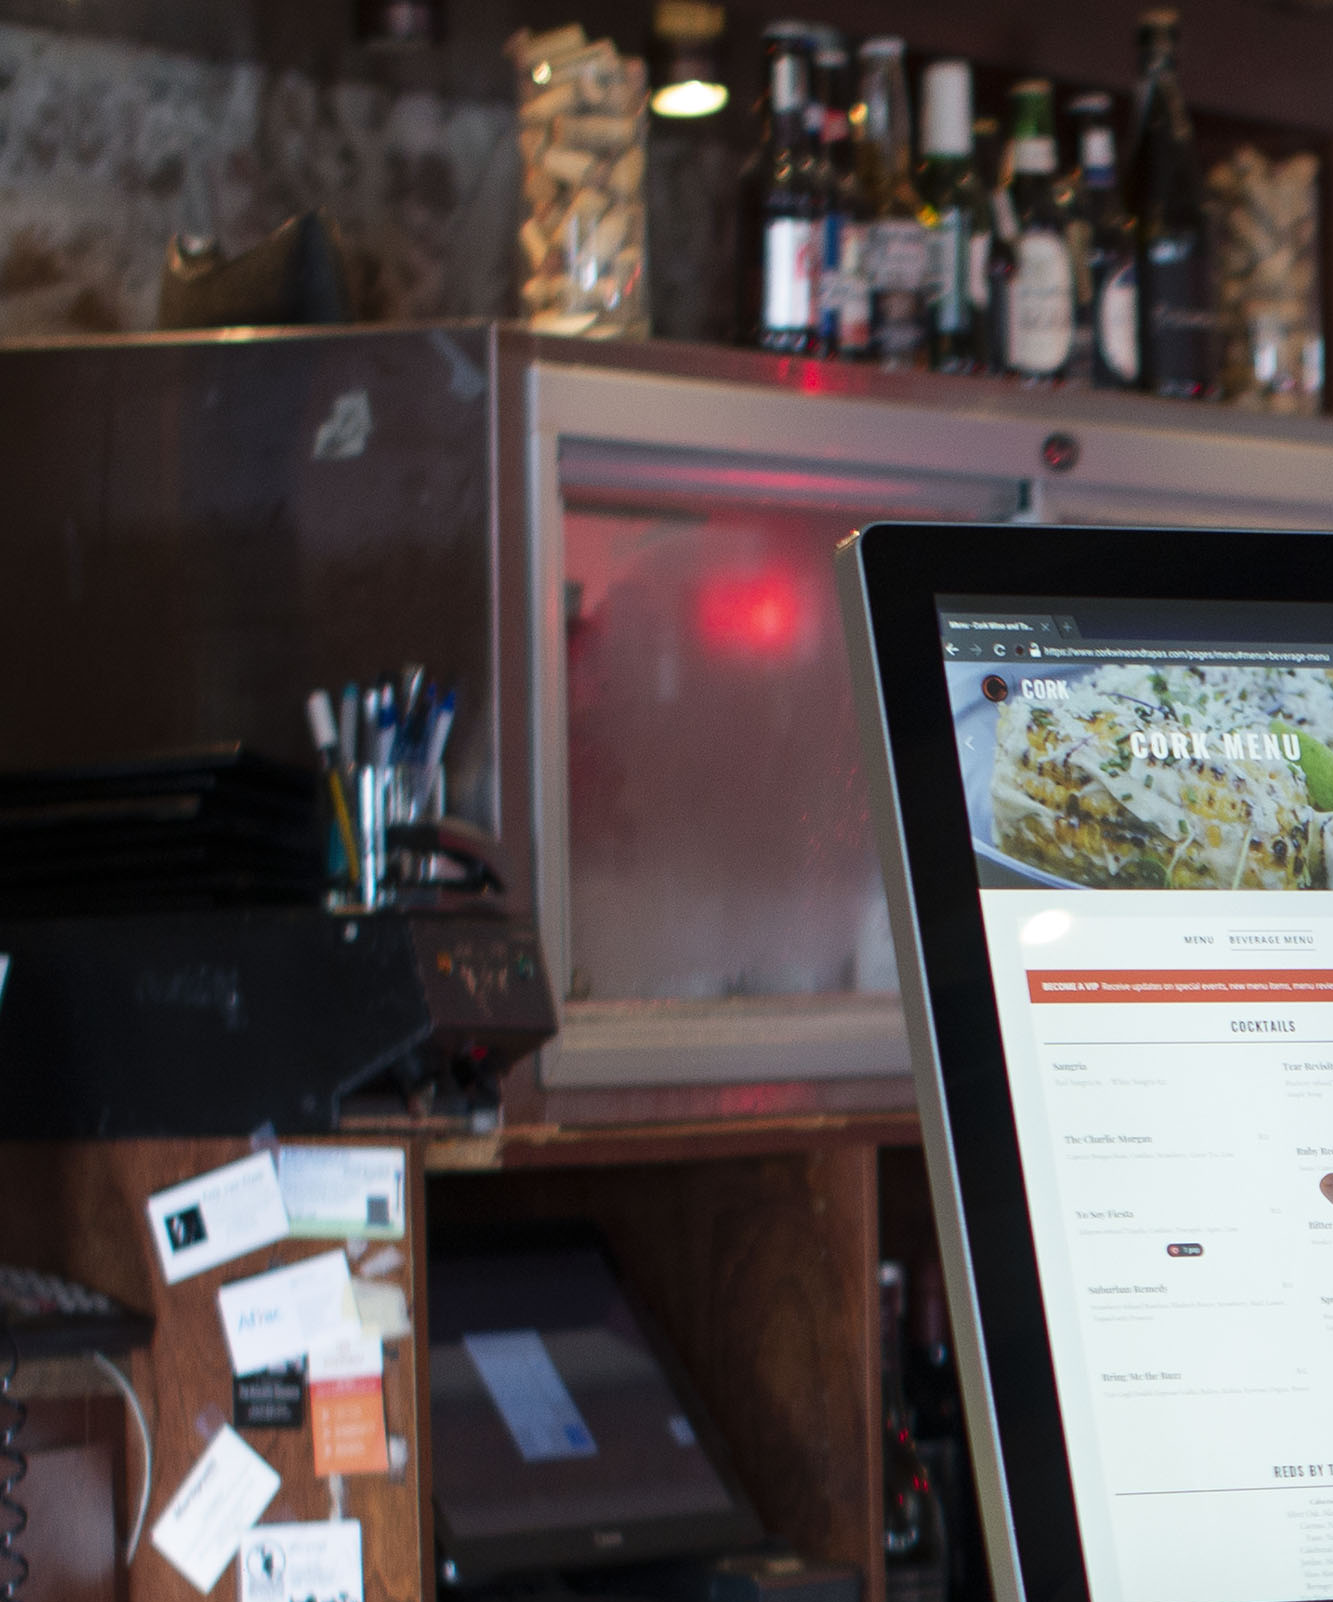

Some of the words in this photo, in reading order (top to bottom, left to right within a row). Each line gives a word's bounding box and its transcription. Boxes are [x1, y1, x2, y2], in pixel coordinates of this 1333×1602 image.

[1021, 679, 1070, 700] CORK
[1130, 731, 1211, 760] CORK
[1225, 733, 1303, 762] MENU
[1183, 935, 1215, 945] MENU
[1229, 935, 1281, 945] BEVERAGE
[1283, 935, 1314, 945] MENU
[1041, 981, 1077, 991] BECOME
[1085, 982, 1100, 991] VIP
[1100, 982, 1131, 991] Receive
[1131, 982, 1162, 993] updates
[1162, 983, 1174, 991] on
[1174, 982, 1201, 993] special
[1201, 983, 1229, 992] events,
[1228, 983, 1246, 991] new
[1246, 983, 1268, 991] menu
[1292, 983, 1315, 991] menu
[1230, 1020, 1296, 1033] COCKTAILS
[1052, 1063, 1088, 1072] Sangria
[1064, 1135, 1083, 1144] The
[1083, 1134, 1116, 1144] Charlie
[1118, 1134, 1153, 1145] Morgan
[1295, 1147, 1318, 1158] Ruby
[1107, 1209, 1135, 1219] Fiesta
[1308, 1220, 1333, 1230] Bitter
[1088, 1284, 1132, 1295] Suburban
[1133, 1282, 1169, 1295] Remedy
[1102, 1373, 1129, 1383] Bring
[1272, 1464, 1305, 1478] REDS
[1309, 1463, 1324, 1477] BY
